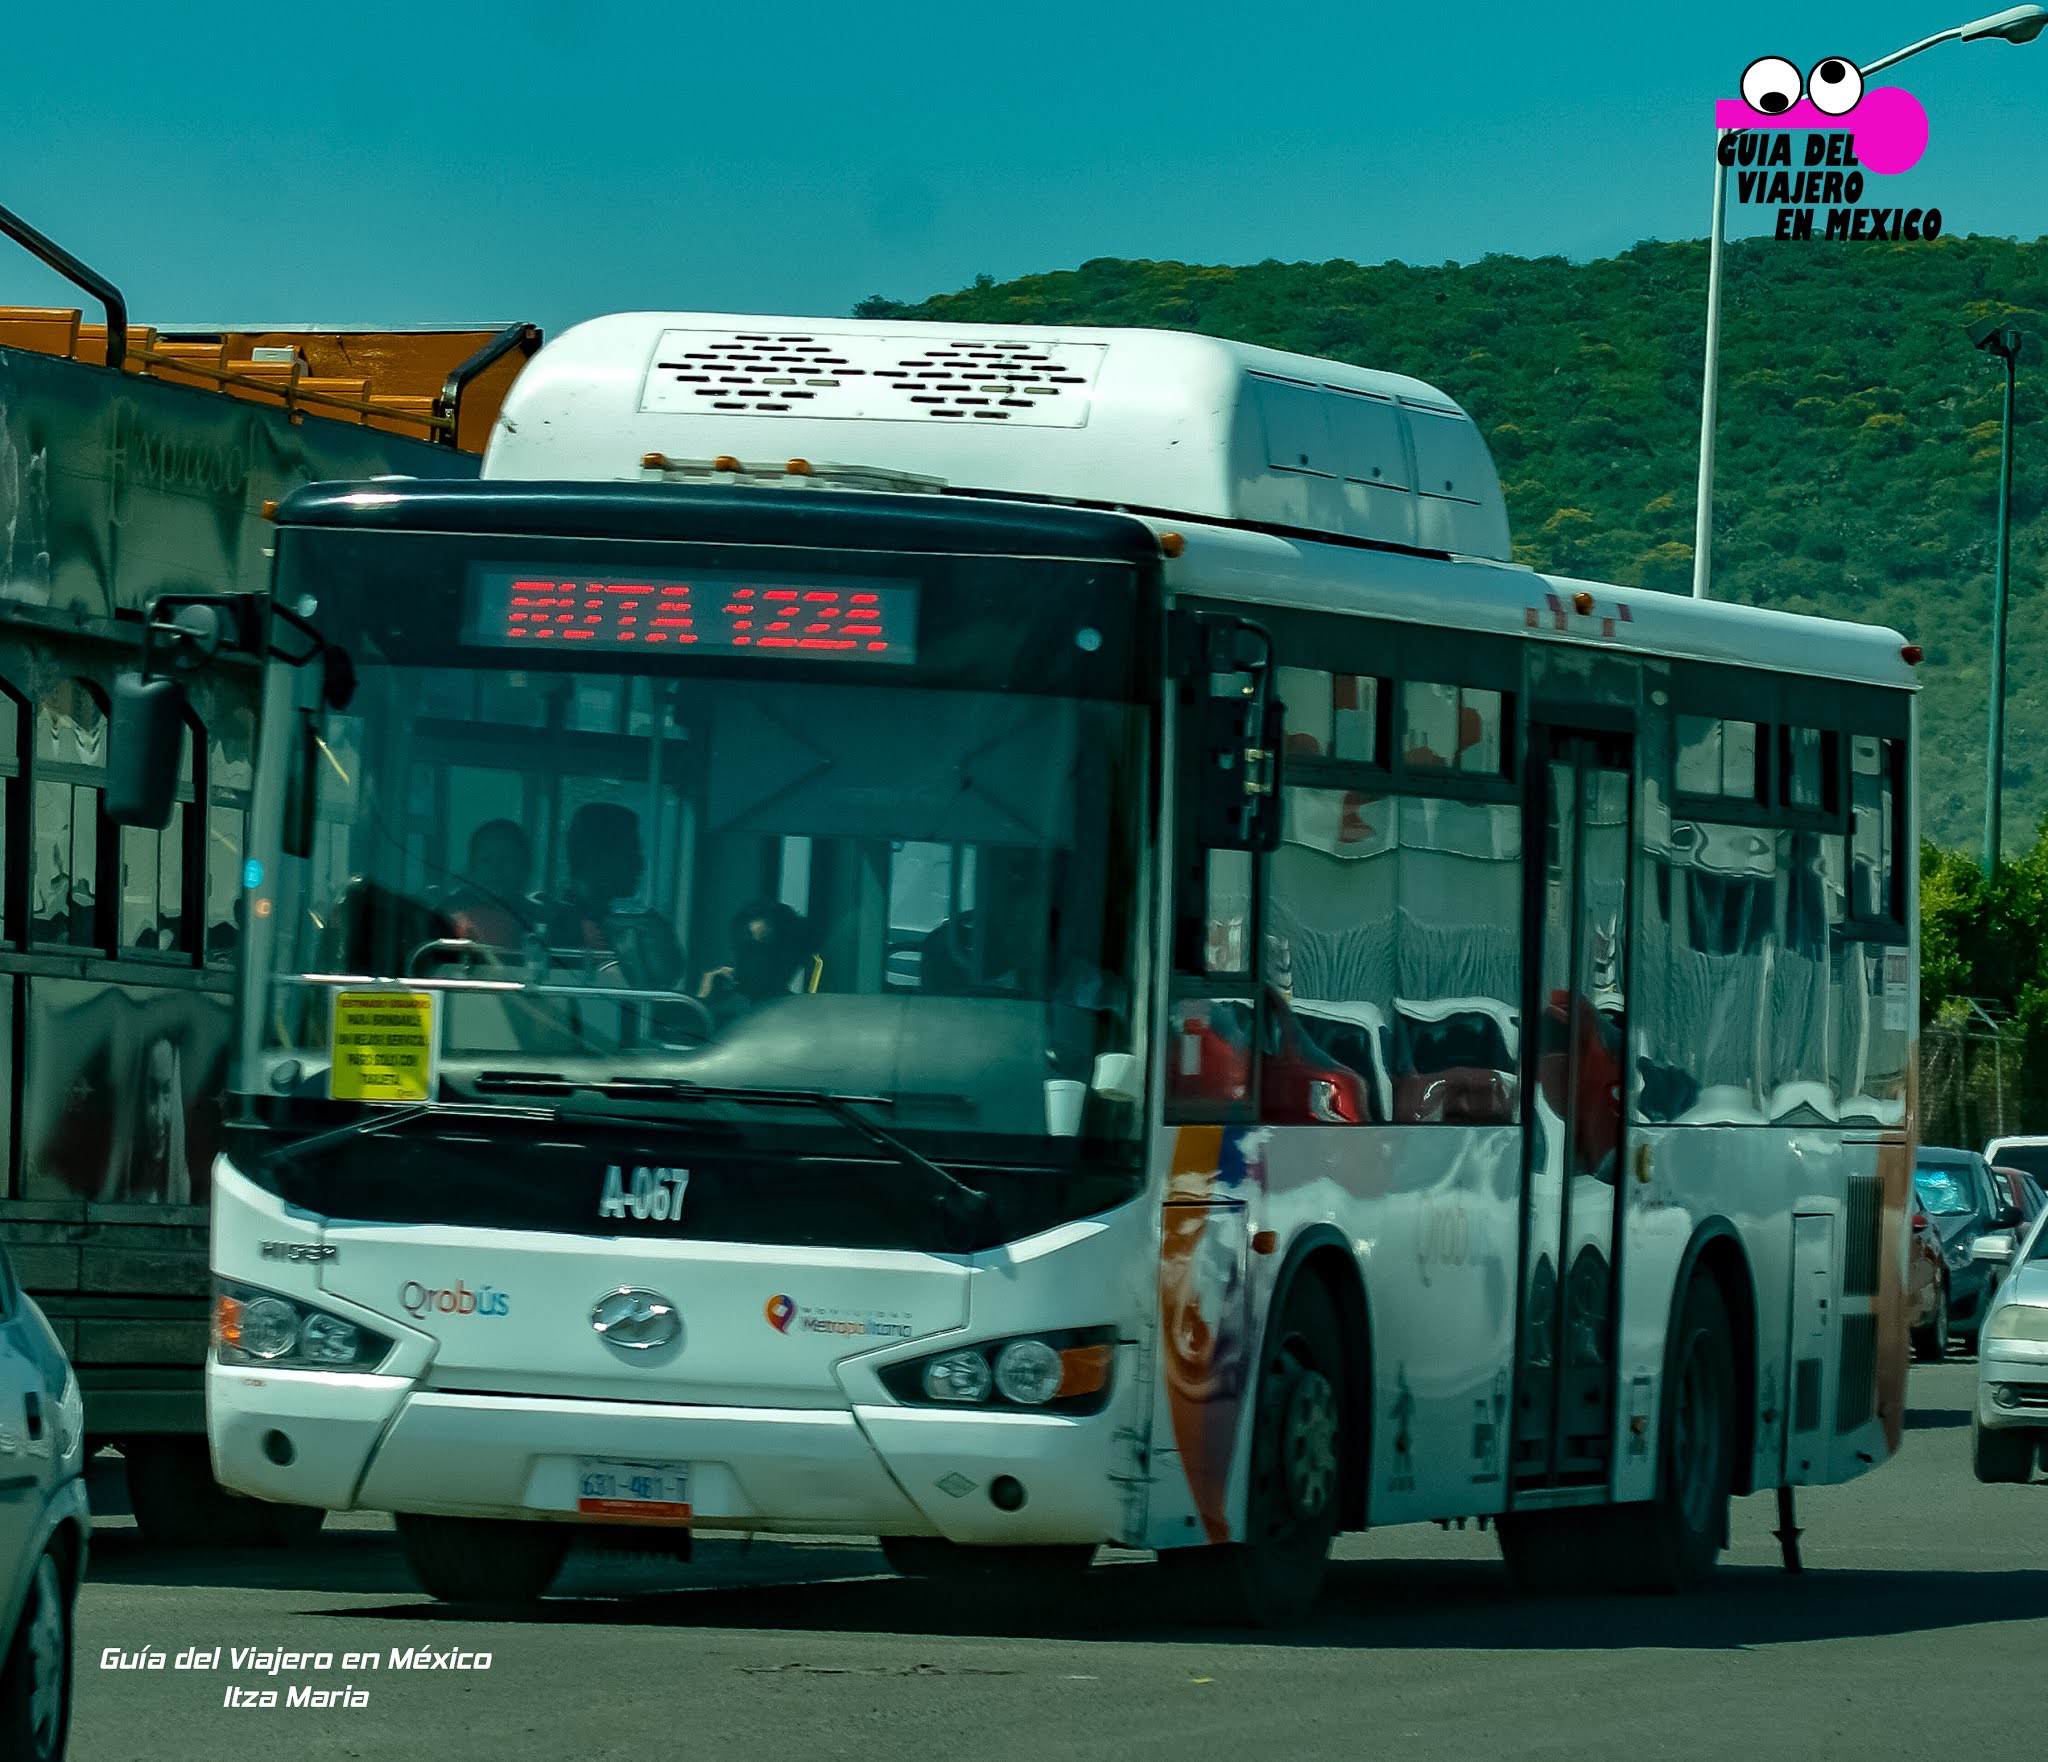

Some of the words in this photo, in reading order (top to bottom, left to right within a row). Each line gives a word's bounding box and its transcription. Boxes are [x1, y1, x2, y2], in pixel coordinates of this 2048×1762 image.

[509, 581, 698, 643] RUTA
[598, 1165, 690, 1221] A-067
[401, 1278, 510, 1319] Qrobús
